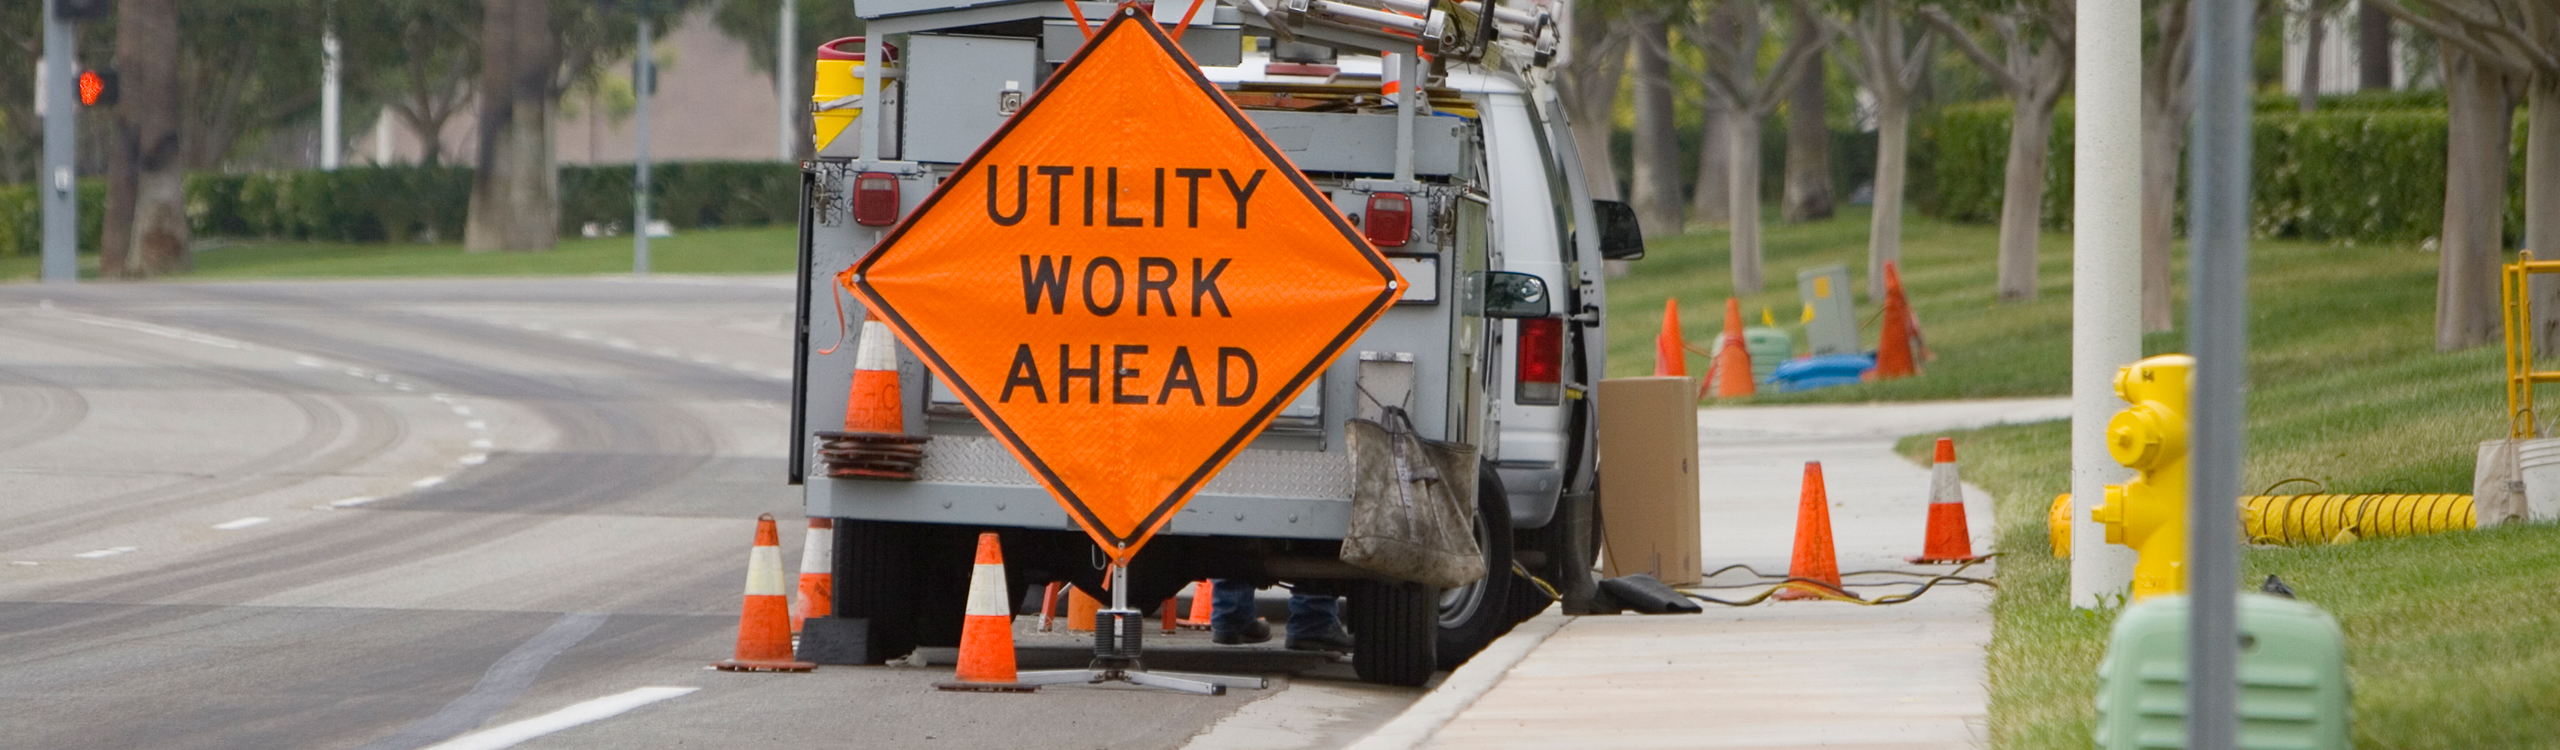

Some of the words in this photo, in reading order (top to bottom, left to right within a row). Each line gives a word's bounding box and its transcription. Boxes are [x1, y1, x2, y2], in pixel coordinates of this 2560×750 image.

[987, 165, 1267, 229] UTILITY
[1020, 254, 1232, 318] WORK
[1000, 343, 1258, 407] AHEAD
